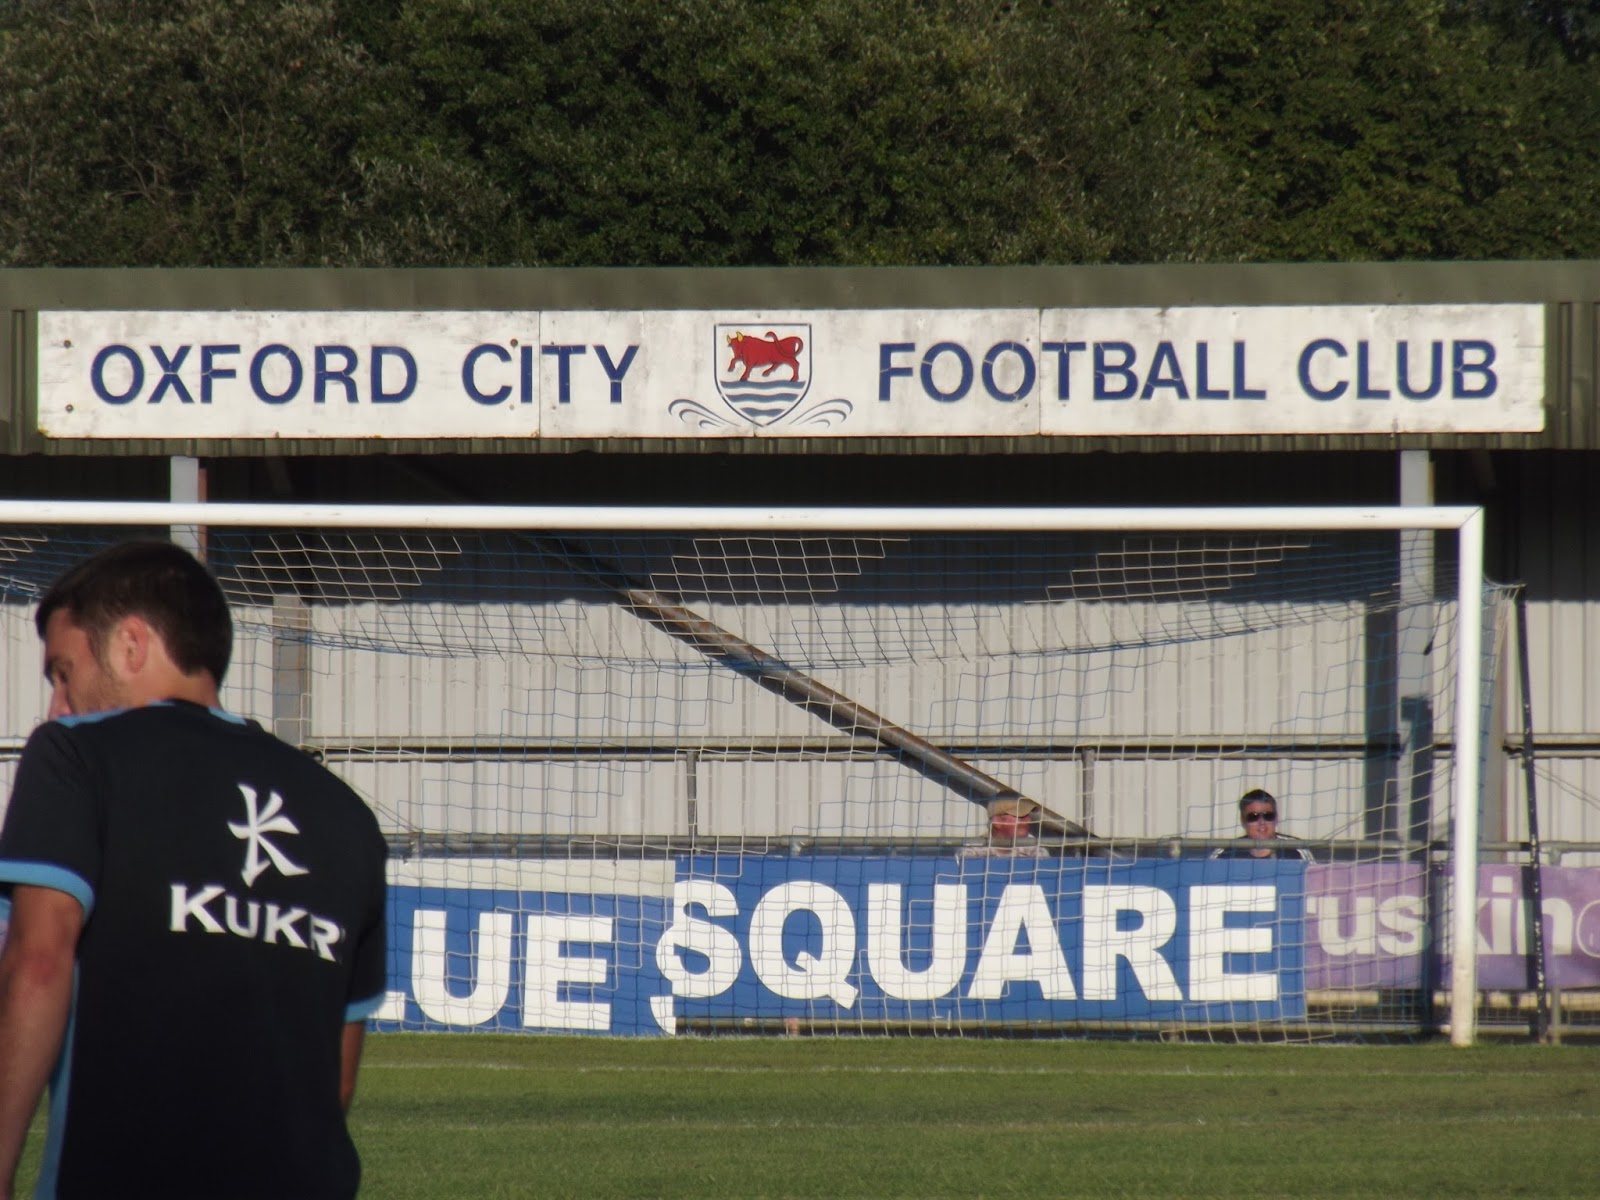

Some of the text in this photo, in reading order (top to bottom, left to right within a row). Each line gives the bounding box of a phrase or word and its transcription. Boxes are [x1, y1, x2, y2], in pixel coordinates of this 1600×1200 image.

[92, 339, 1497, 406] OXFORD CITY FOOTBALL CLUB
[170, 884, 346, 963] KUKR
[368, 880, 1277, 1031] UE SQUARE
[1307, 876, 1573, 956] uskin
